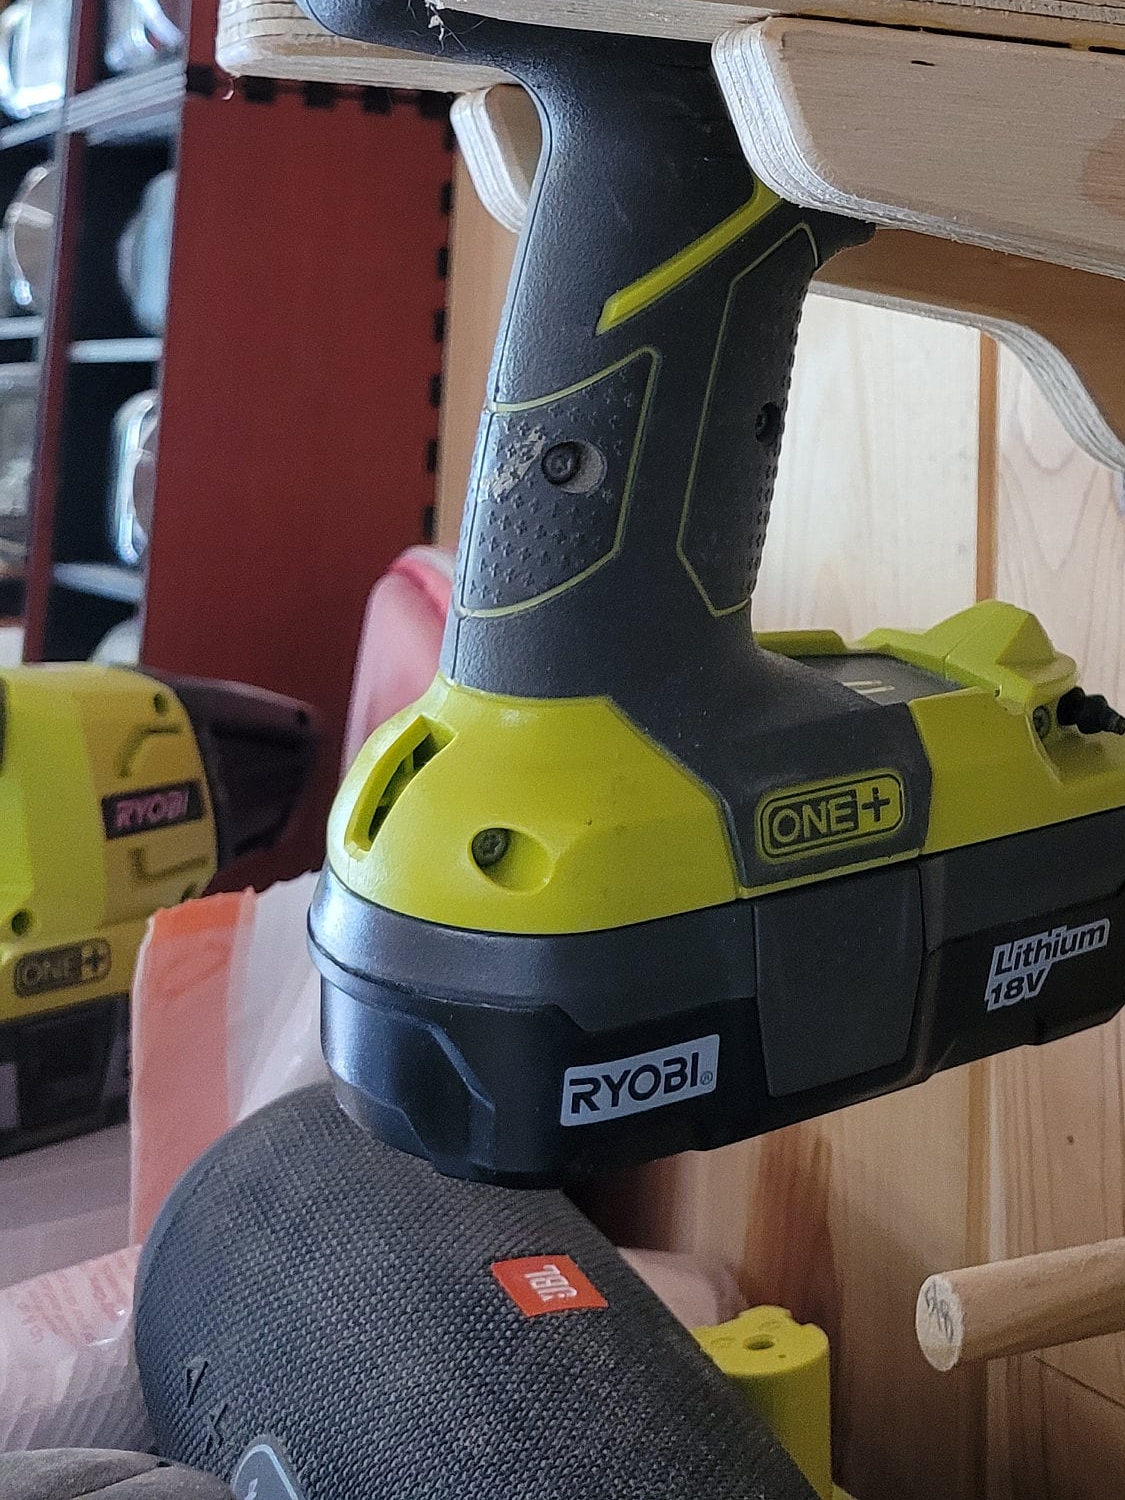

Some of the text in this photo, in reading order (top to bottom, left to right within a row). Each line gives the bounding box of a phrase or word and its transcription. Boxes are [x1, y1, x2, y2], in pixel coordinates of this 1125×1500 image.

[115, 790, 189, 828] RYOBI
[772, 787, 892, 843] ONE+
[995, 924, 1106, 976] Lithium
[991, 968, 1046, 1004] 18V
[568, 1051, 700, 1114] RYOBI
[524, 1264, 578, 1302] JBL
